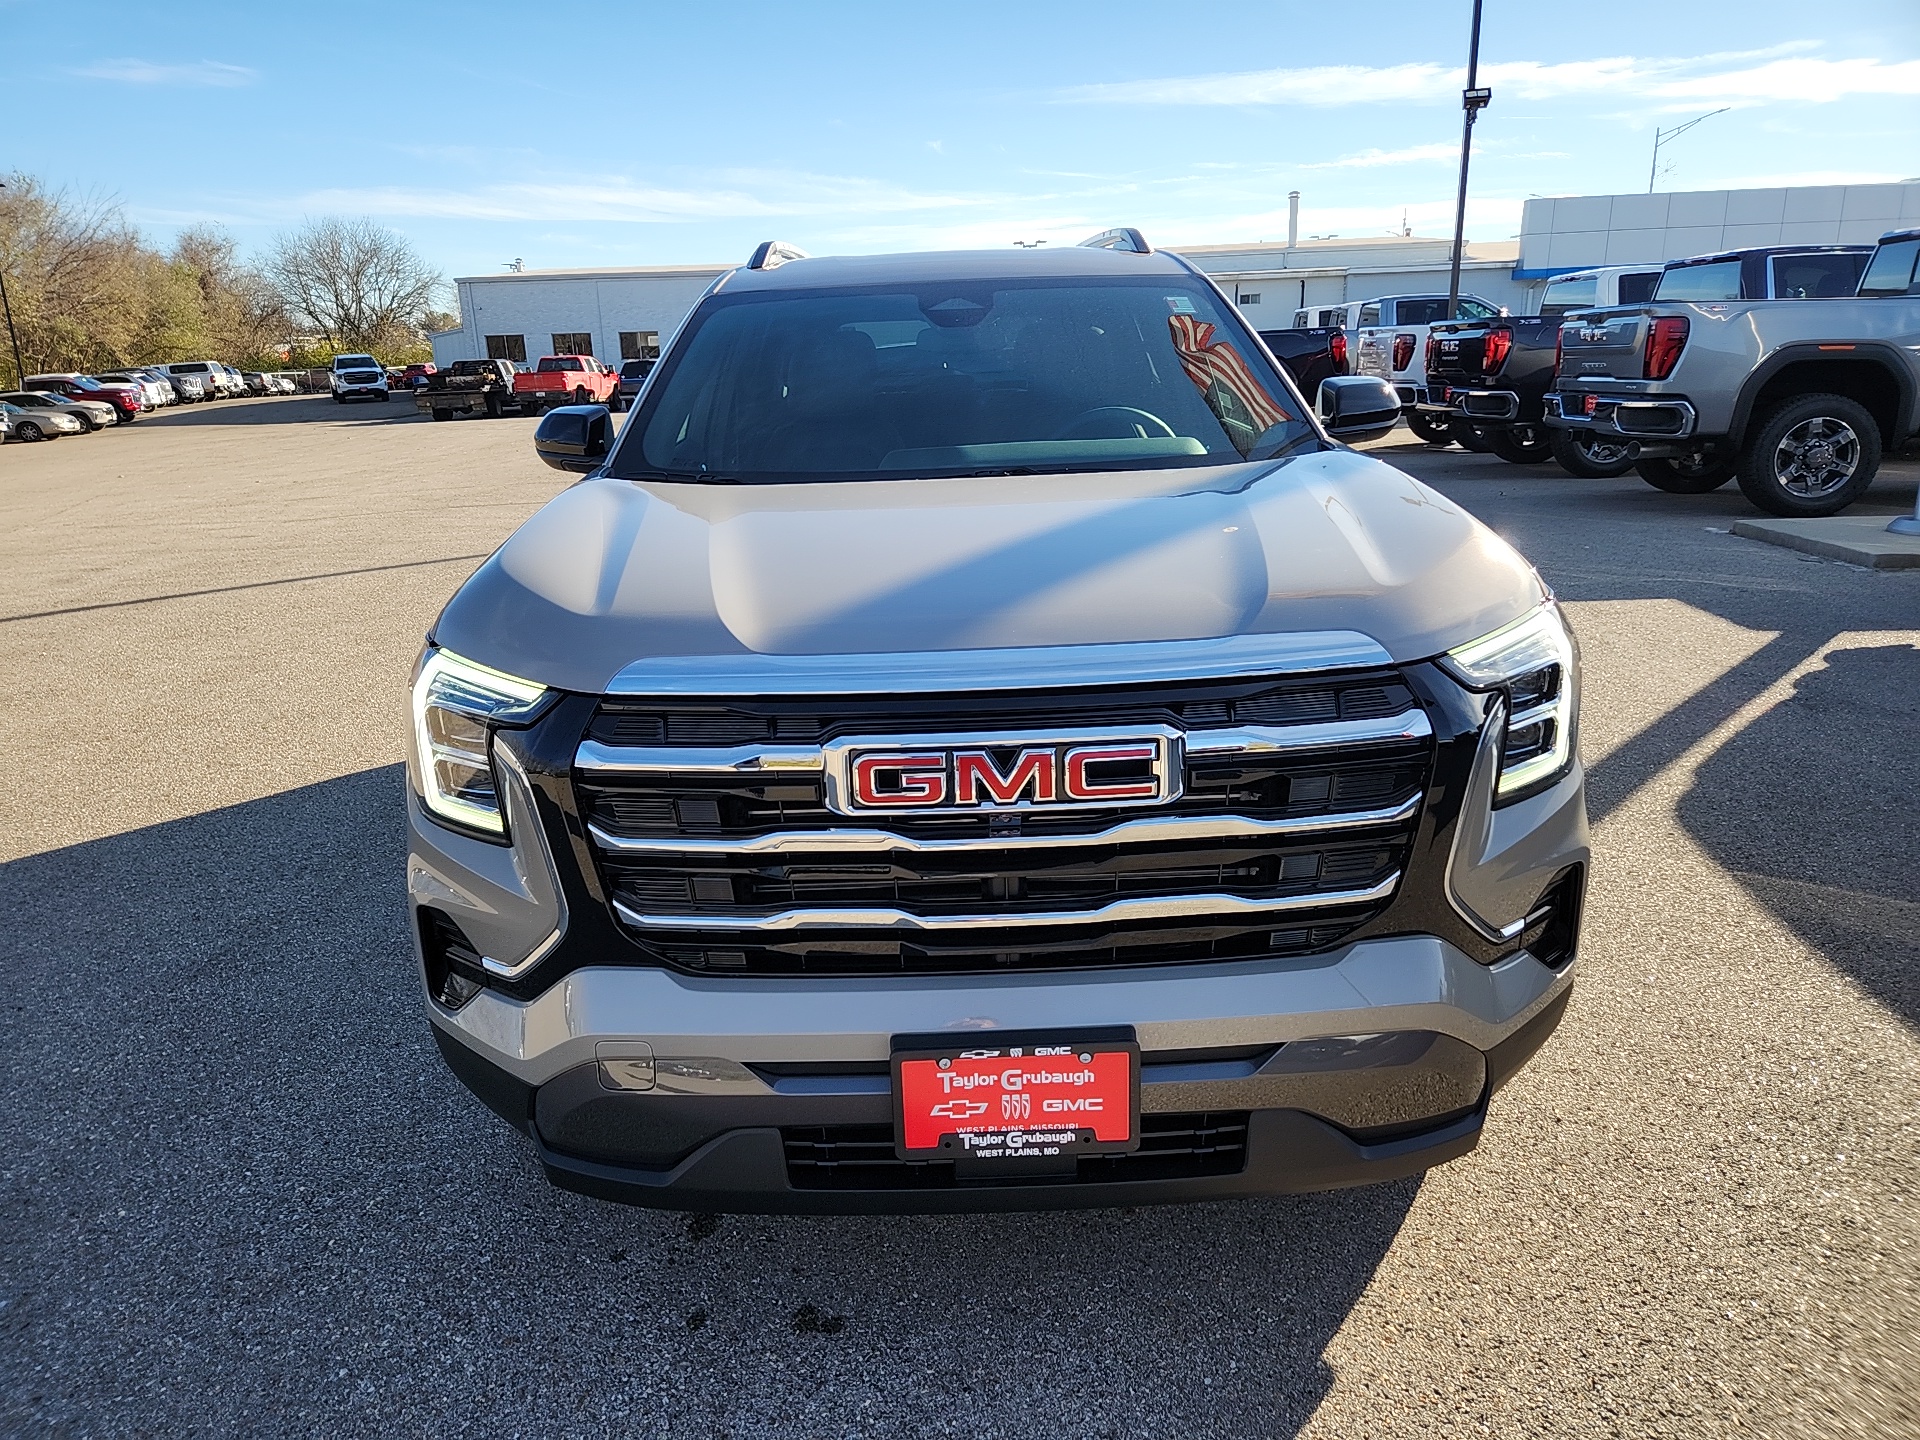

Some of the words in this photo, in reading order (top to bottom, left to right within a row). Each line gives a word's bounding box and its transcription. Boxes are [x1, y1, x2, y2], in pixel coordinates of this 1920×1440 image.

[852, 743, 1157, 804] GMC
[1034, 1046, 1072, 1056] GMC
[936, 1071, 998, 1093] Taylor
[1000, 1069, 1095, 1091] Grubaugh
[1042, 1098, 1103, 1112] GMC
[958, 1133, 1005, 1150] Taylor
[1006, 1130, 1076, 1148] Grubaugh
[976, 1149, 1004, 1158] WEST
[1005, 1148, 1042, 1157] PLAINS,
[1043, 1146, 1060, 1156] MO
